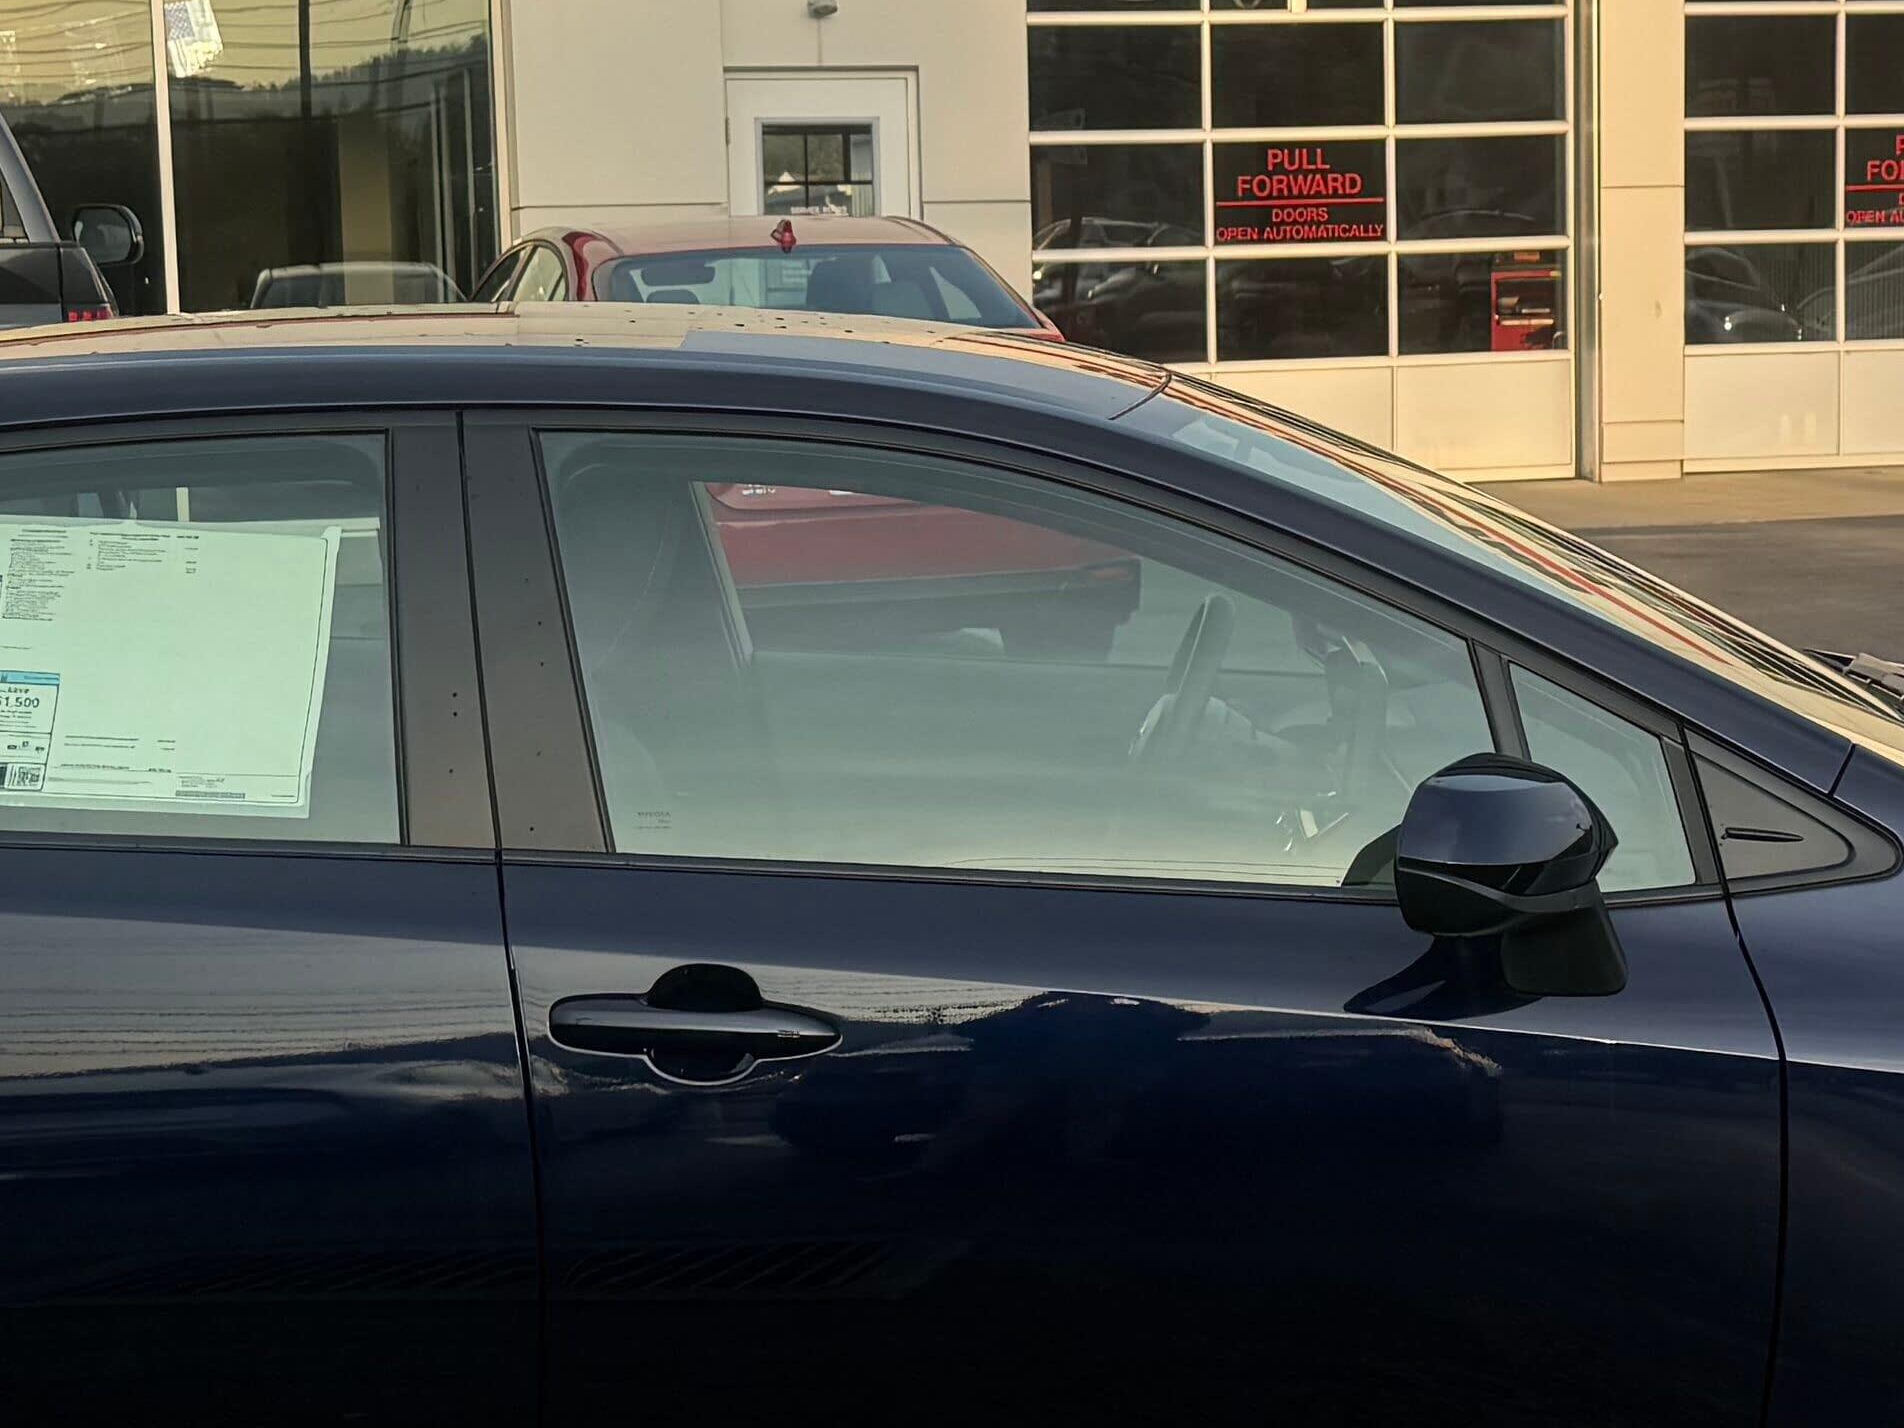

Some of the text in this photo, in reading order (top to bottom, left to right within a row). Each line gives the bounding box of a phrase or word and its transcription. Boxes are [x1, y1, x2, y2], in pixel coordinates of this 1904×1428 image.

[1267, 148, 1331, 171] PULL
[1237, 173, 1362, 197] FORWARD
[1272, 207, 1329, 222] DOORS
[1846, 210, 1885, 224] OPEN
[1216, 224, 1384, 241] OPEN AUTOMATICALLY
